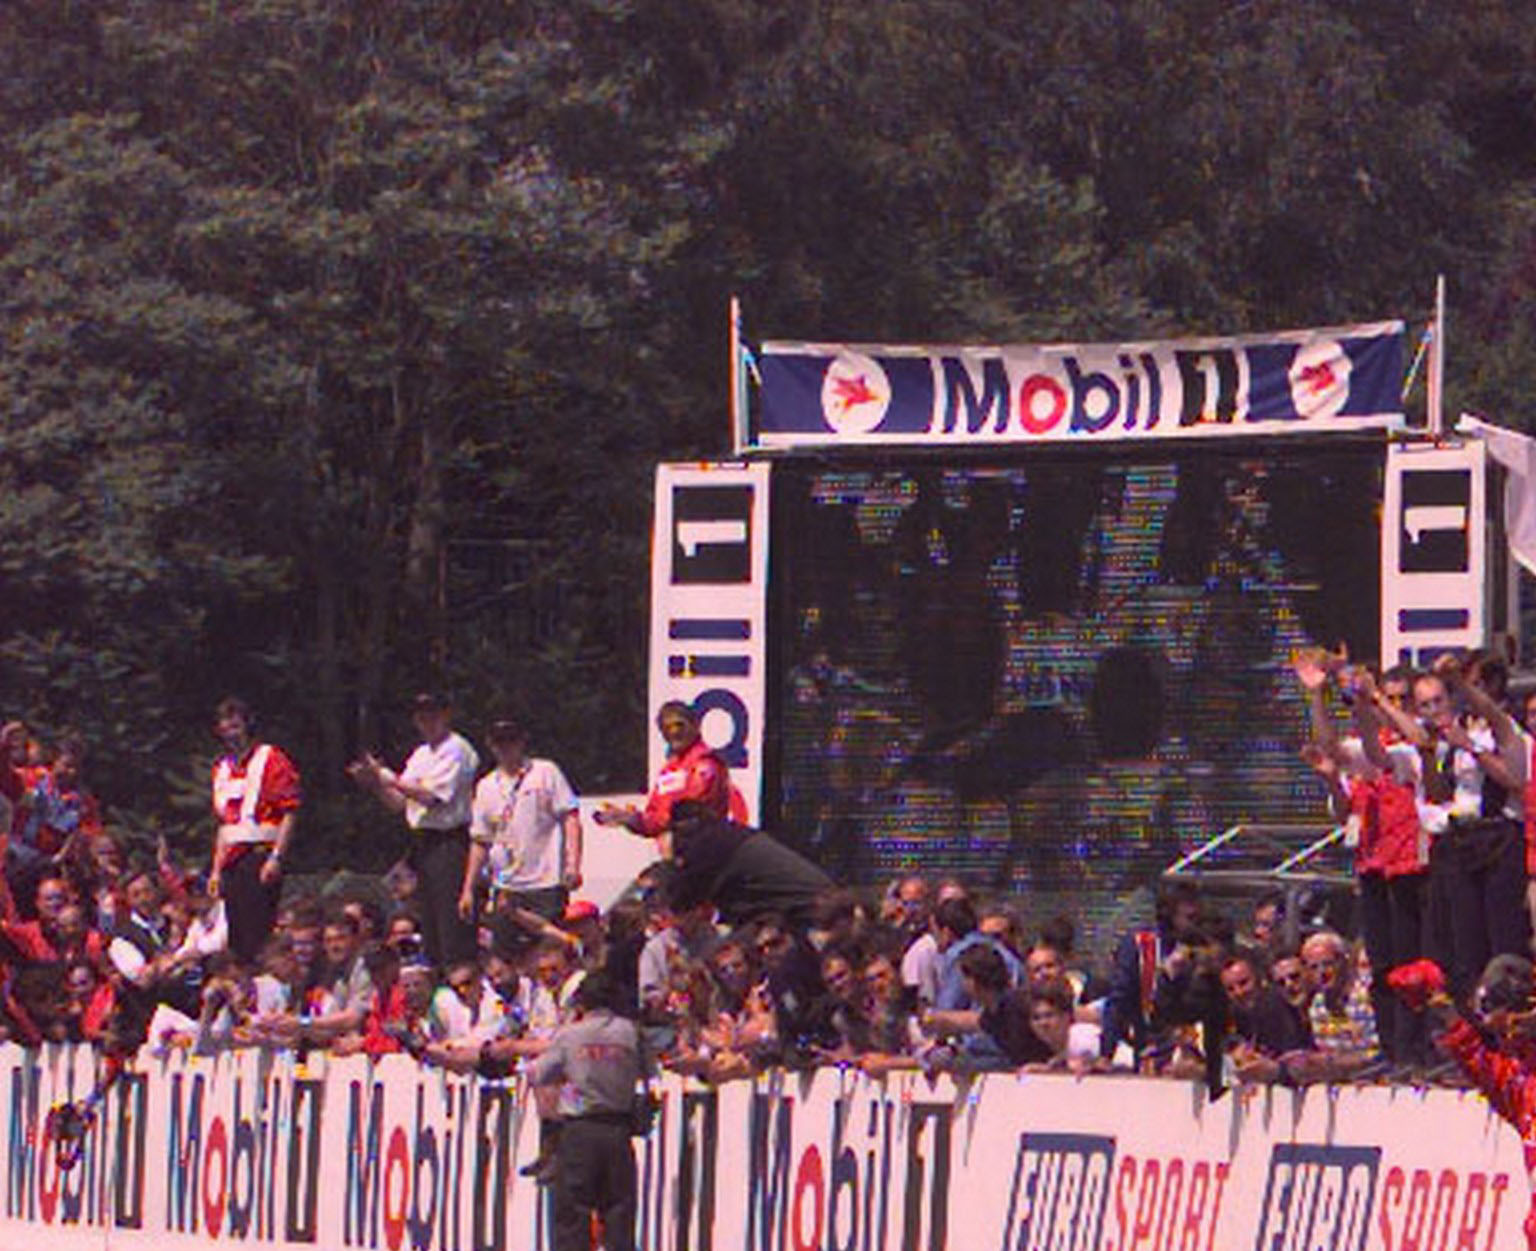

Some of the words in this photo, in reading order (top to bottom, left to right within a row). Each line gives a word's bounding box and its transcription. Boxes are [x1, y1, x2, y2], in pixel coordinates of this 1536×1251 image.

[941, 352, 1162, 434] Mobil
[677, 520, 748, 558] 1
[1404, 505, 1467, 545] 1
[668, 618, 752, 770] bil
[166, 1073, 281, 1242] Mobil
